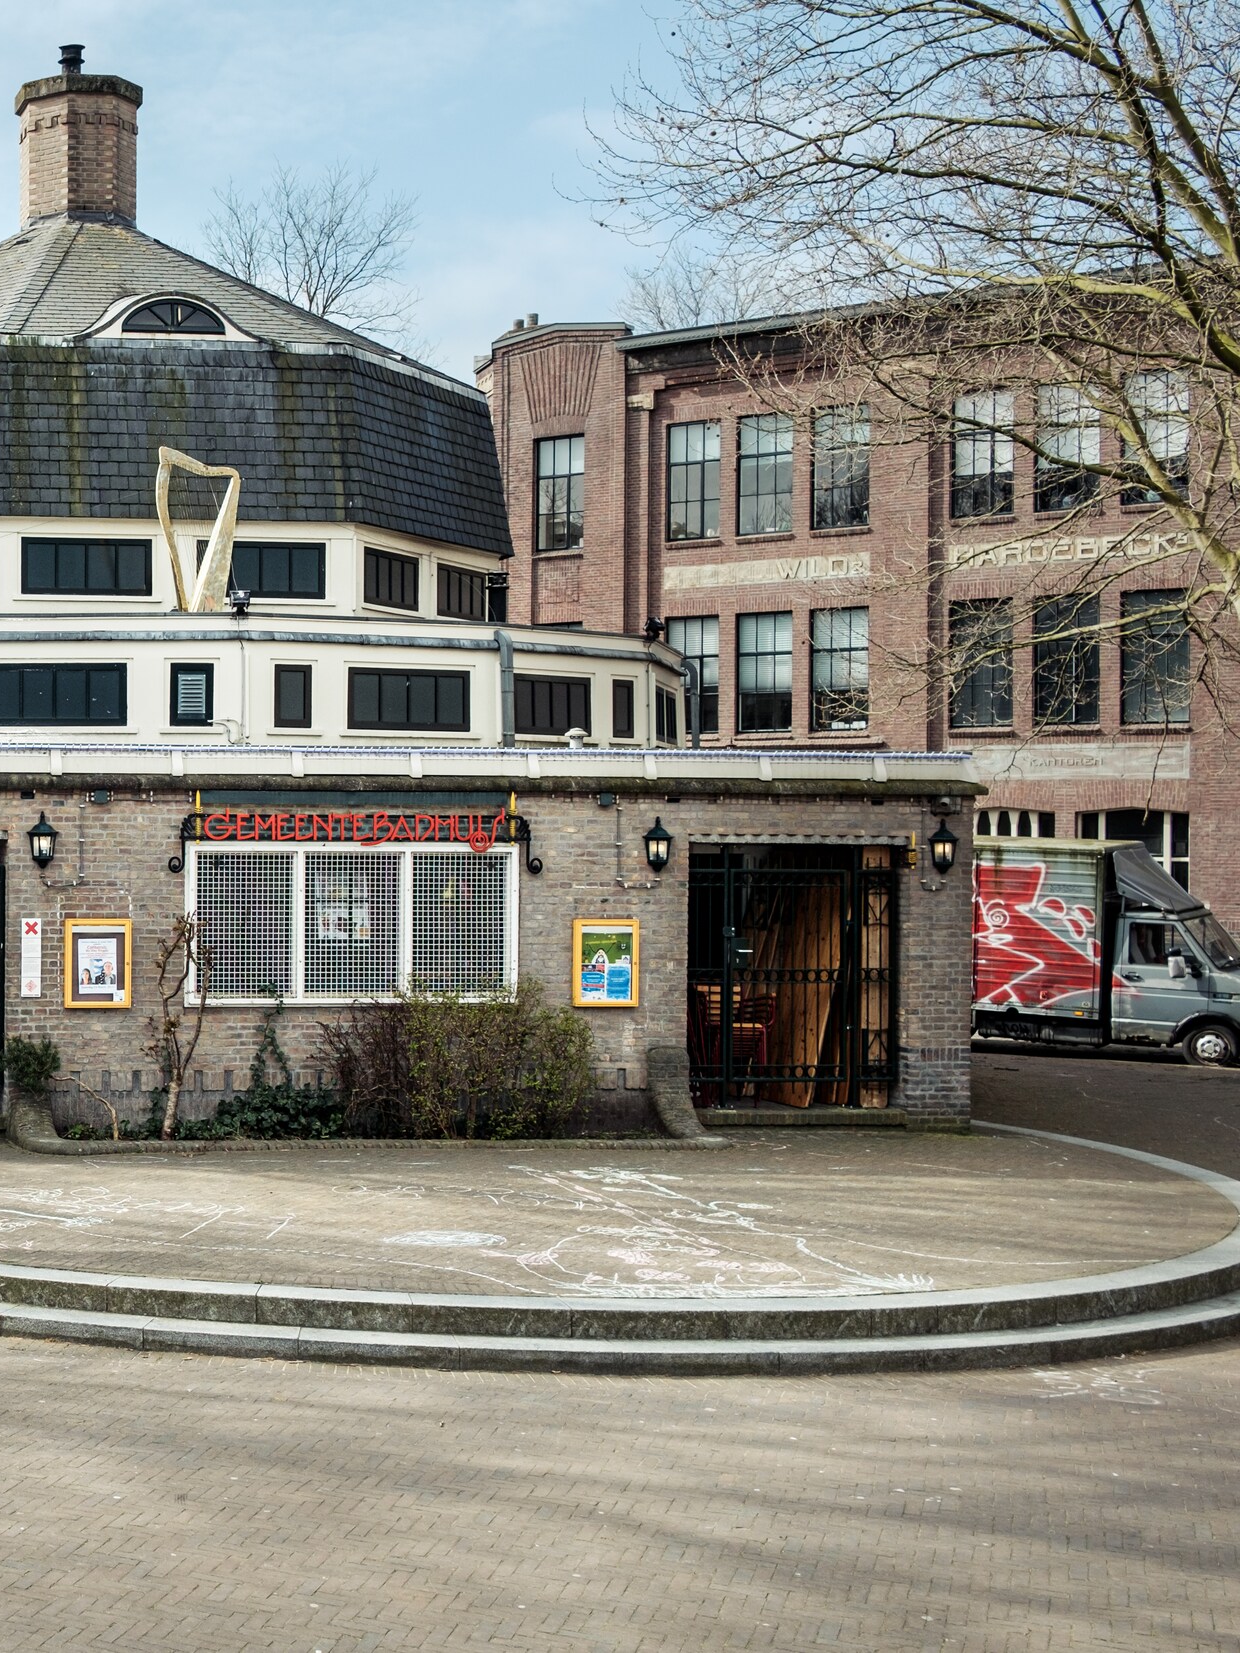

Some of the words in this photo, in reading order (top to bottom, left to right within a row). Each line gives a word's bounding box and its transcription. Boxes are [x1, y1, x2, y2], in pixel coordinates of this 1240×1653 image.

[776, 557, 848, 580] WILD
[1029, 757, 1104, 767] KANTOREN
[204, 808, 505, 853] GEMEENTEBADHUIS
